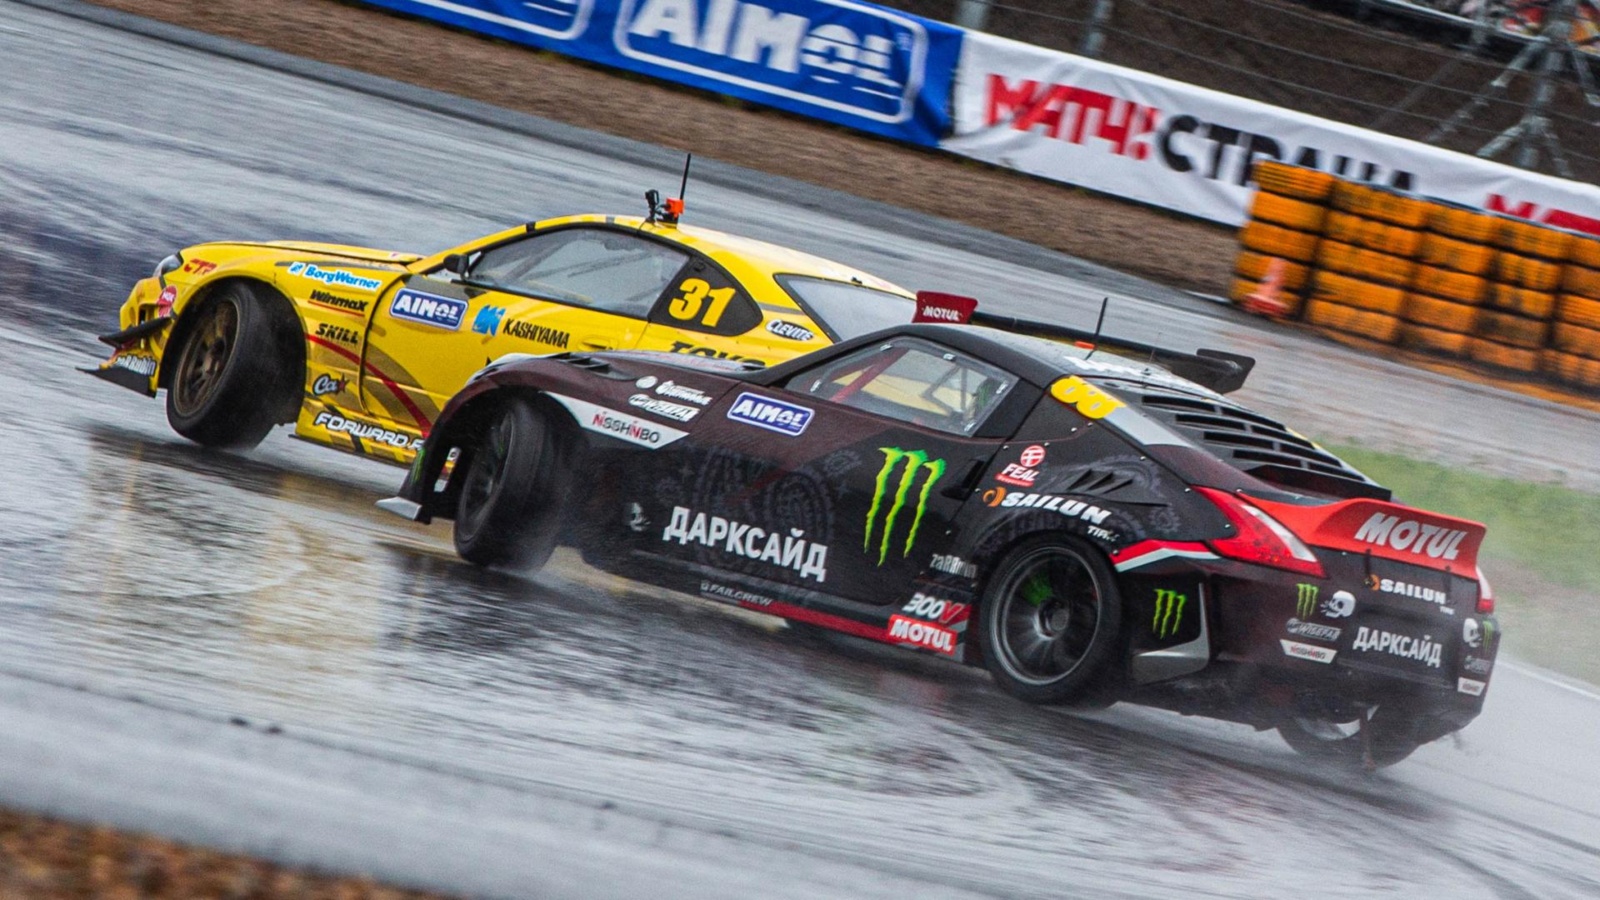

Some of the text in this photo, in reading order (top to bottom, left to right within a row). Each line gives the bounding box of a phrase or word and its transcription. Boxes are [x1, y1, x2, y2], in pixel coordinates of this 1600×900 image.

[305, 265, 380, 289] BorgWarner
[394, 294, 460, 321] AIMOL
[668, 277, 737, 328] 31
[923, 305, 960, 322] MOTUL
[315, 323, 359, 344] SKILL
[502, 318, 570, 349] KASHIYAMA
[732, 399, 804, 428] AIMOL
[1001, 462, 1040, 482] FEAL
[1000, 491, 1112, 525] SAILUN
[662, 505, 829, 583] ДАРКСАЙД
[1354, 511, 1468, 561] MOTUL
[708, 583, 774, 606] FAILCREW
[1379, 578, 1446, 605] SAILUN
[902, 592, 964, 624] 300V
[889, 618, 953, 652] MOTUL
[1353, 626, 1443, 668] ДАРКСАЙД
